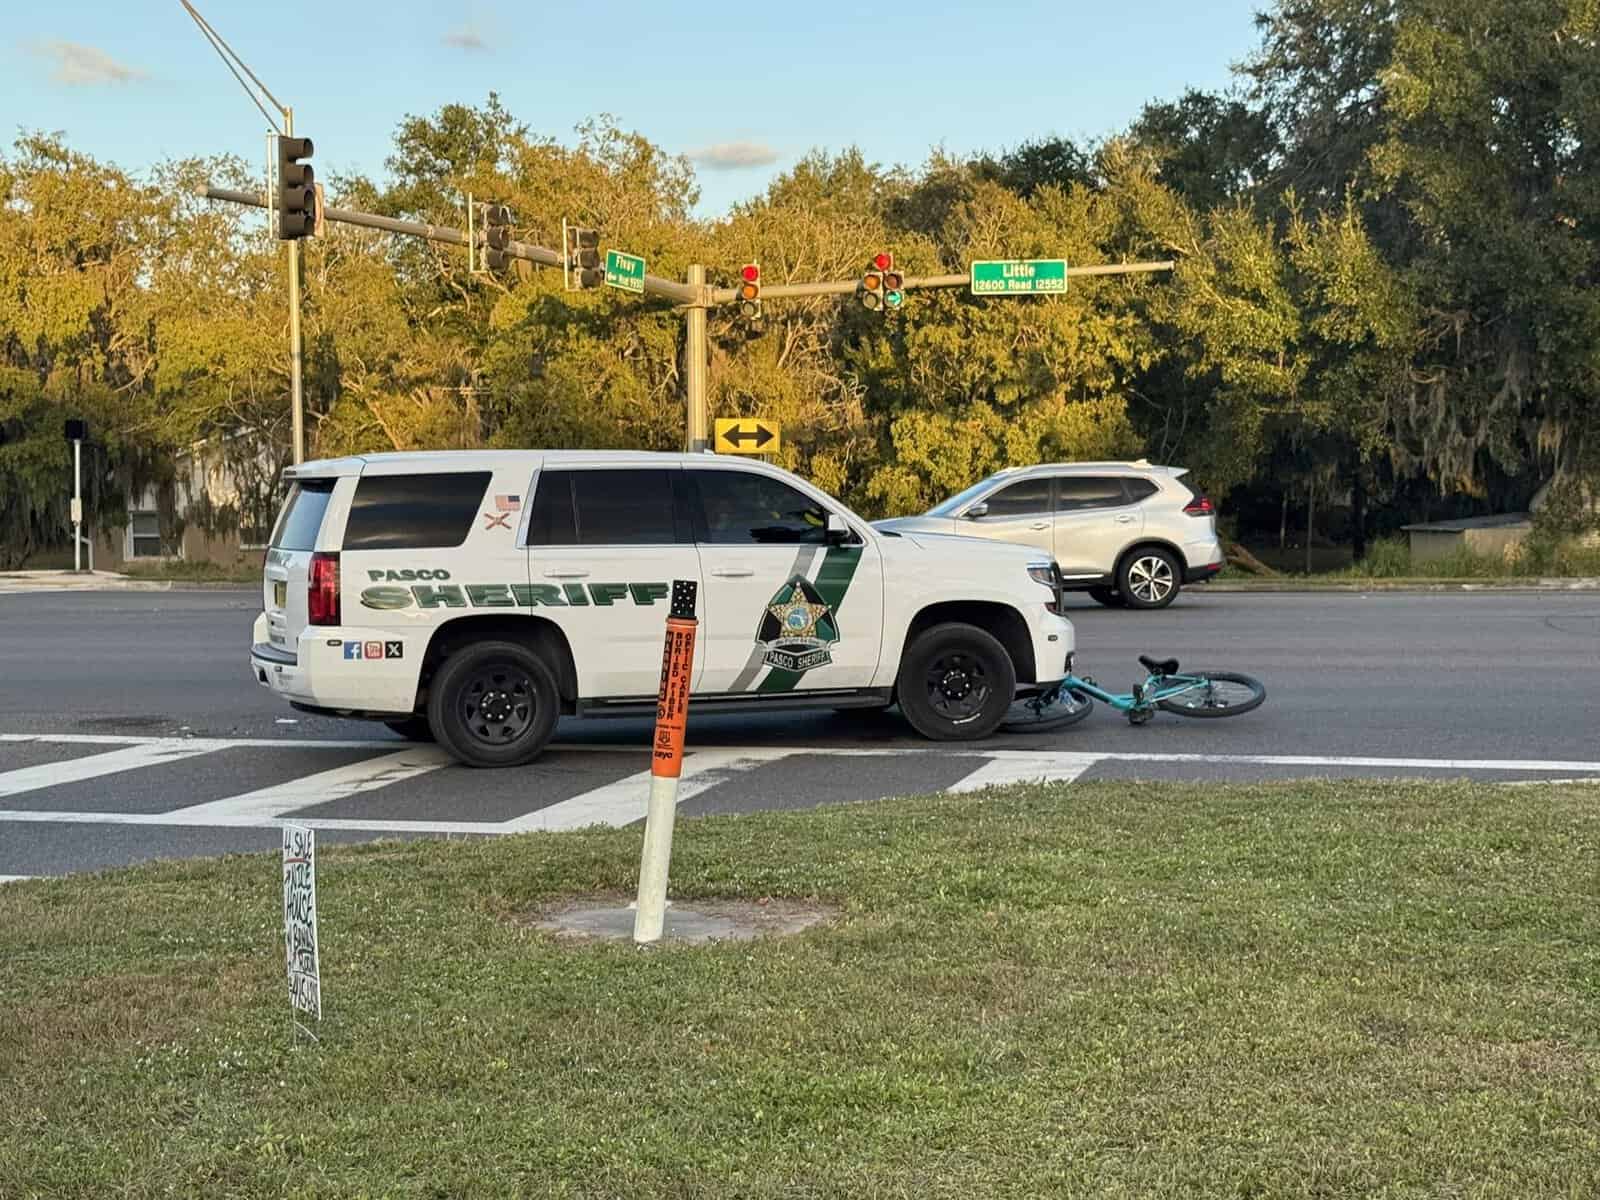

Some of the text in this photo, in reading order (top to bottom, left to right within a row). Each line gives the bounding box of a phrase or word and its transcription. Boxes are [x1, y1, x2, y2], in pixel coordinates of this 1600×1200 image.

[1002, 264, 1036, 278] Little
[1008, 279, 1033, 289] Road
[367, 569, 451, 581] PASCO
[360, 582, 669, 610] SHERIFF
[671, 632, 683, 678] BURIED
[682, 633, 692, 671] OPTIC
[769, 651, 827, 669] PASCO SHERIFF
